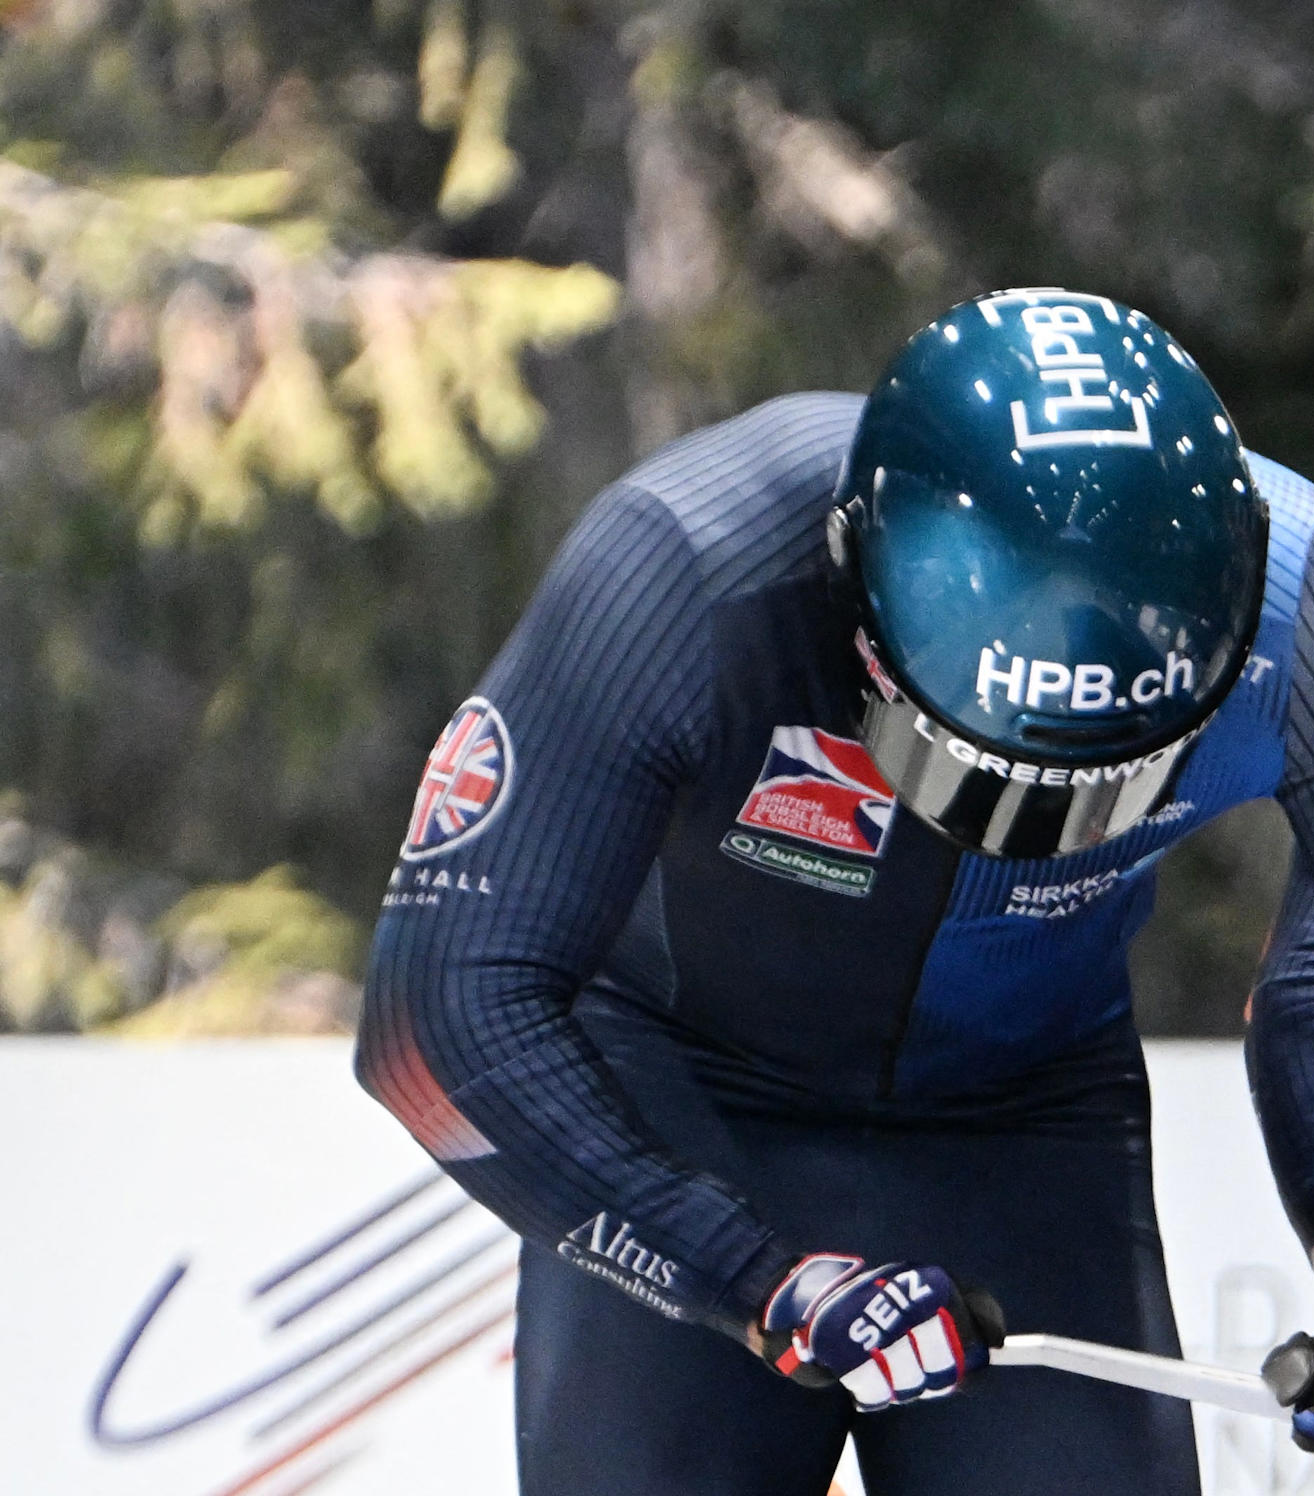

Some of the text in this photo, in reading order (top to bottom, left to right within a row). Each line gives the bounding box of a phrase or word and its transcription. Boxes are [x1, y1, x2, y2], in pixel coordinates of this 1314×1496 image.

[976, 647, 1195, 711] HPB.ch
[762, 846, 867, 883] Autohorn
[556, 1240, 684, 1320] Consulting
[566, 1210, 681, 1289] Altus
